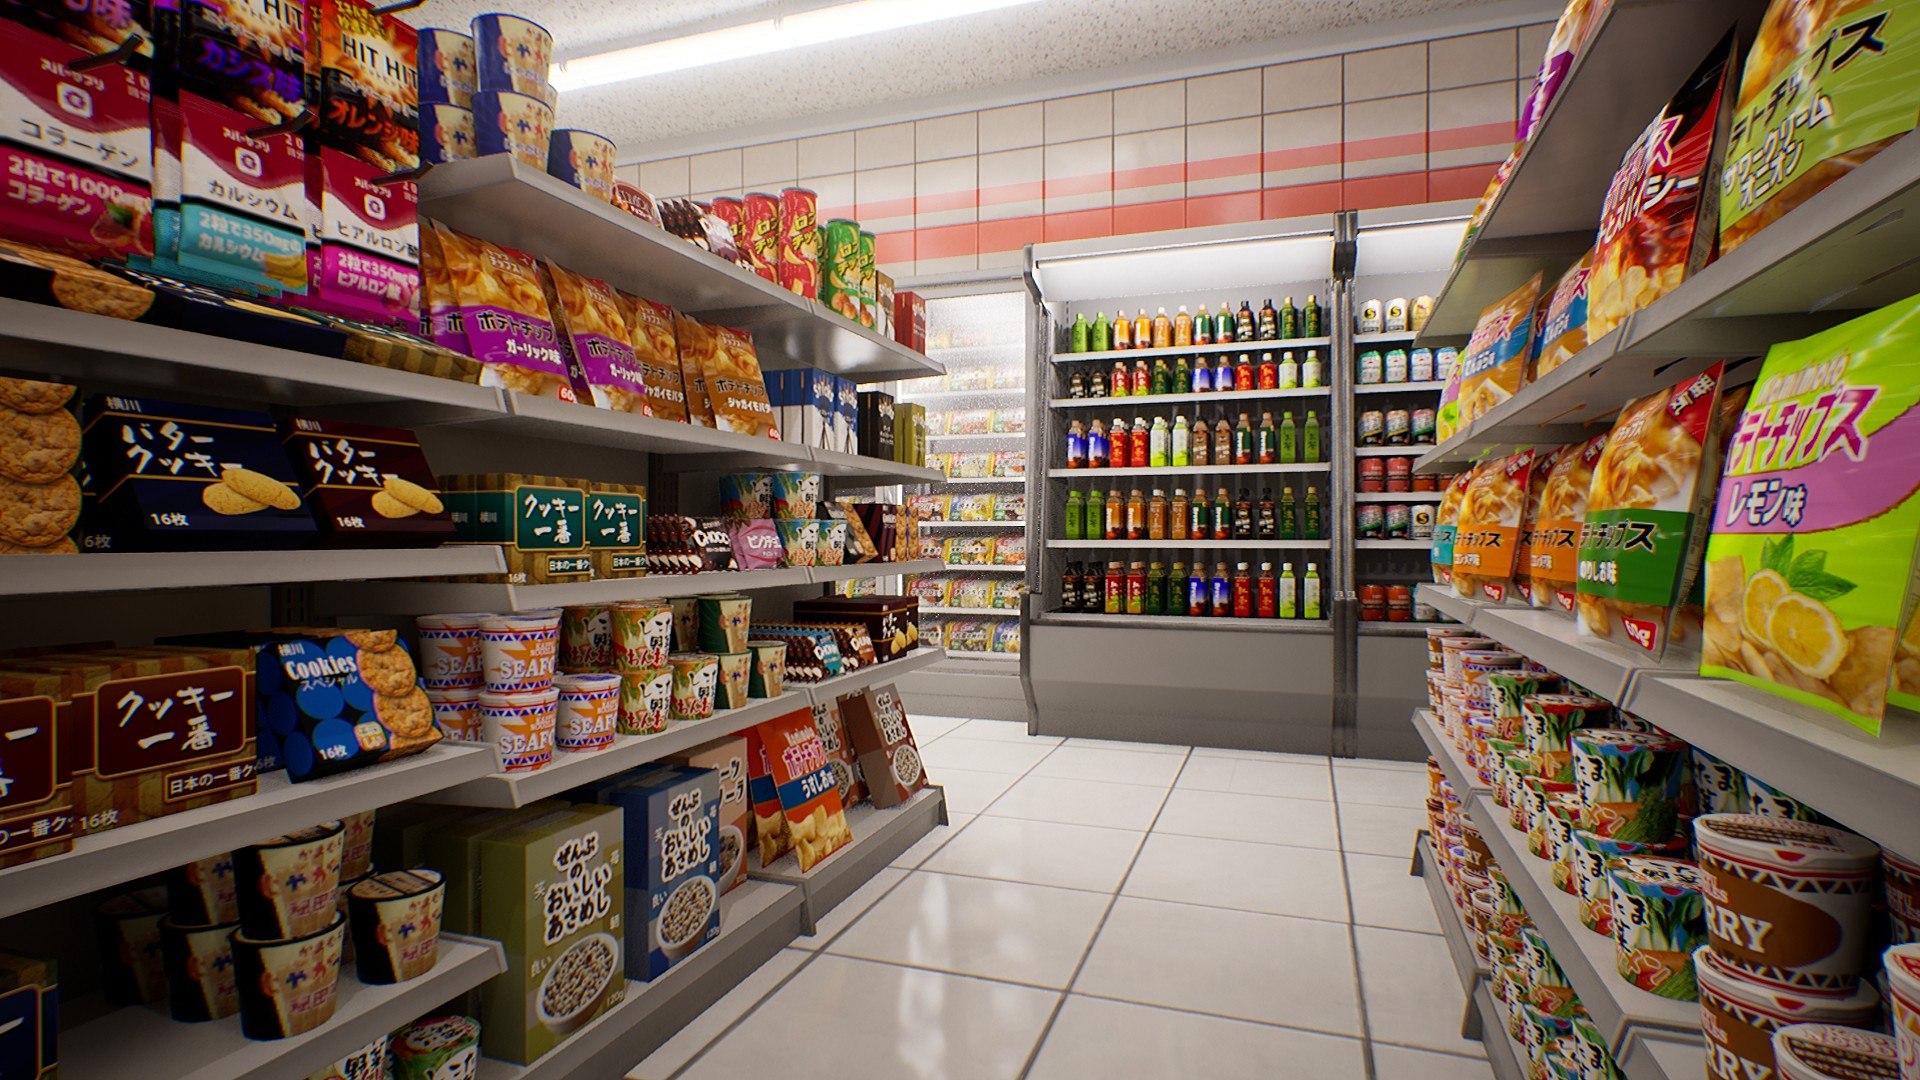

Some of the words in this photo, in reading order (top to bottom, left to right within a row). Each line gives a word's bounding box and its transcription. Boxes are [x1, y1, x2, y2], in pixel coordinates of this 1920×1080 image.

[198, 40, 304, 104] カシス味
[342, 33, 379, 69] HIT
[385, 55, 418, 91] HIT
[1727, 9, 1893, 158] テトチップス
[20, 118, 139, 168] コラーゲン
[327, 99, 418, 156] オレンジ味
[1722, 88, 1834, 197] サワークリーム
[1739, 140, 1804, 211] オニオン
[8, 179, 92, 216] コラーゲン
[209, 179, 299, 221] カルシウム
[199, 232, 266, 263] カルシウム
[506, 338, 563, 366] ガーリック味
[122, 421, 214, 451] バター
[309, 438, 376, 465] バター
[126, 444, 243, 477] クッキー
[314, 458, 399, 487] クッキー
[524, 493, 580, 519] クッキー
[593, 499, 638, 521] クッキー
[1725, 476, 1808, 528] レモン味
[151, 512, 189, 527] 16枚
[337, 516, 365, 529] 16枚
[534, 519, 572, 545] 一番
[601, 521, 631, 544] 一番
[508, 573, 527, 584] 16枚
[550, 558, 590, 572] 日本の一番ク
[285, 655, 358, 681] Cookies
[301, 674, 358, 692] スペシャル
[116, 686, 234, 728] クッキー
[137, 717, 217, 752] 一番
[320, 744, 348, 760] 16枚
[170, 762, 256, 795] 日本の一番ク
[79, 808, 119, 830] 16枚
[670, 791, 700, 818] ぜんぶ
[554, 832, 598, 870] ぜんぶ
[664, 818, 709, 856] おいしい
[569, 861, 583, 880] の
[664, 840, 708, 880] あさめし
[545, 865, 611, 915] おいしい
[545, 889, 610, 944] あさめし
